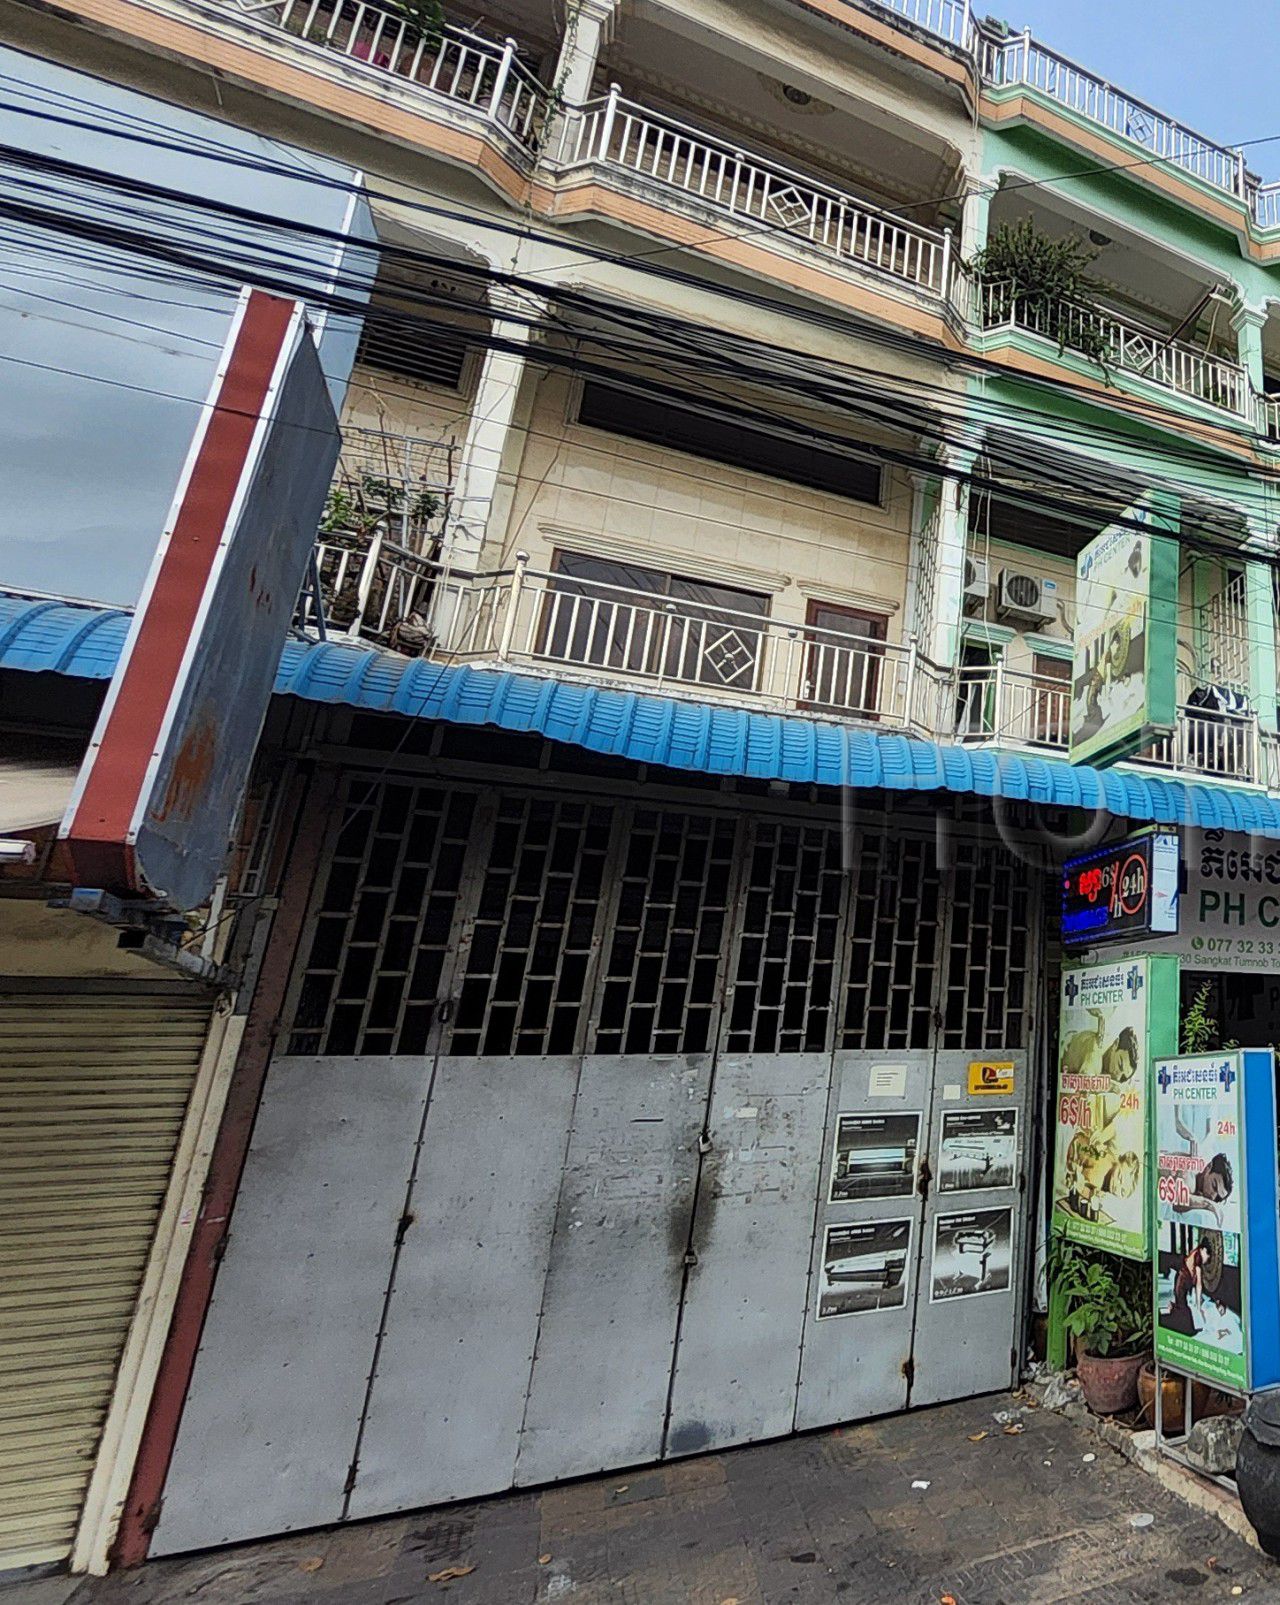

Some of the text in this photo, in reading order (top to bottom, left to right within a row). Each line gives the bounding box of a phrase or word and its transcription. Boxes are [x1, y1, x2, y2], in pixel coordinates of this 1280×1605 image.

[1122, 867, 1145, 898] 24h
[1199, 889, 1246, 925] PH
[1207, 938, 1232, 952] 077
[1237, 940, 1254, 954] 32
[1258, 941, 1274, 955] 33
[1194, 954, 1232, 967] Sangkat
[1081, 989, 1124, 1005] PH CENTER
[1119, 1093, 1139, 1110] 24h
[1173, 1088, 1218, 1099] PH CENTER
[1217, 1120, 1236, 1136] 24h
